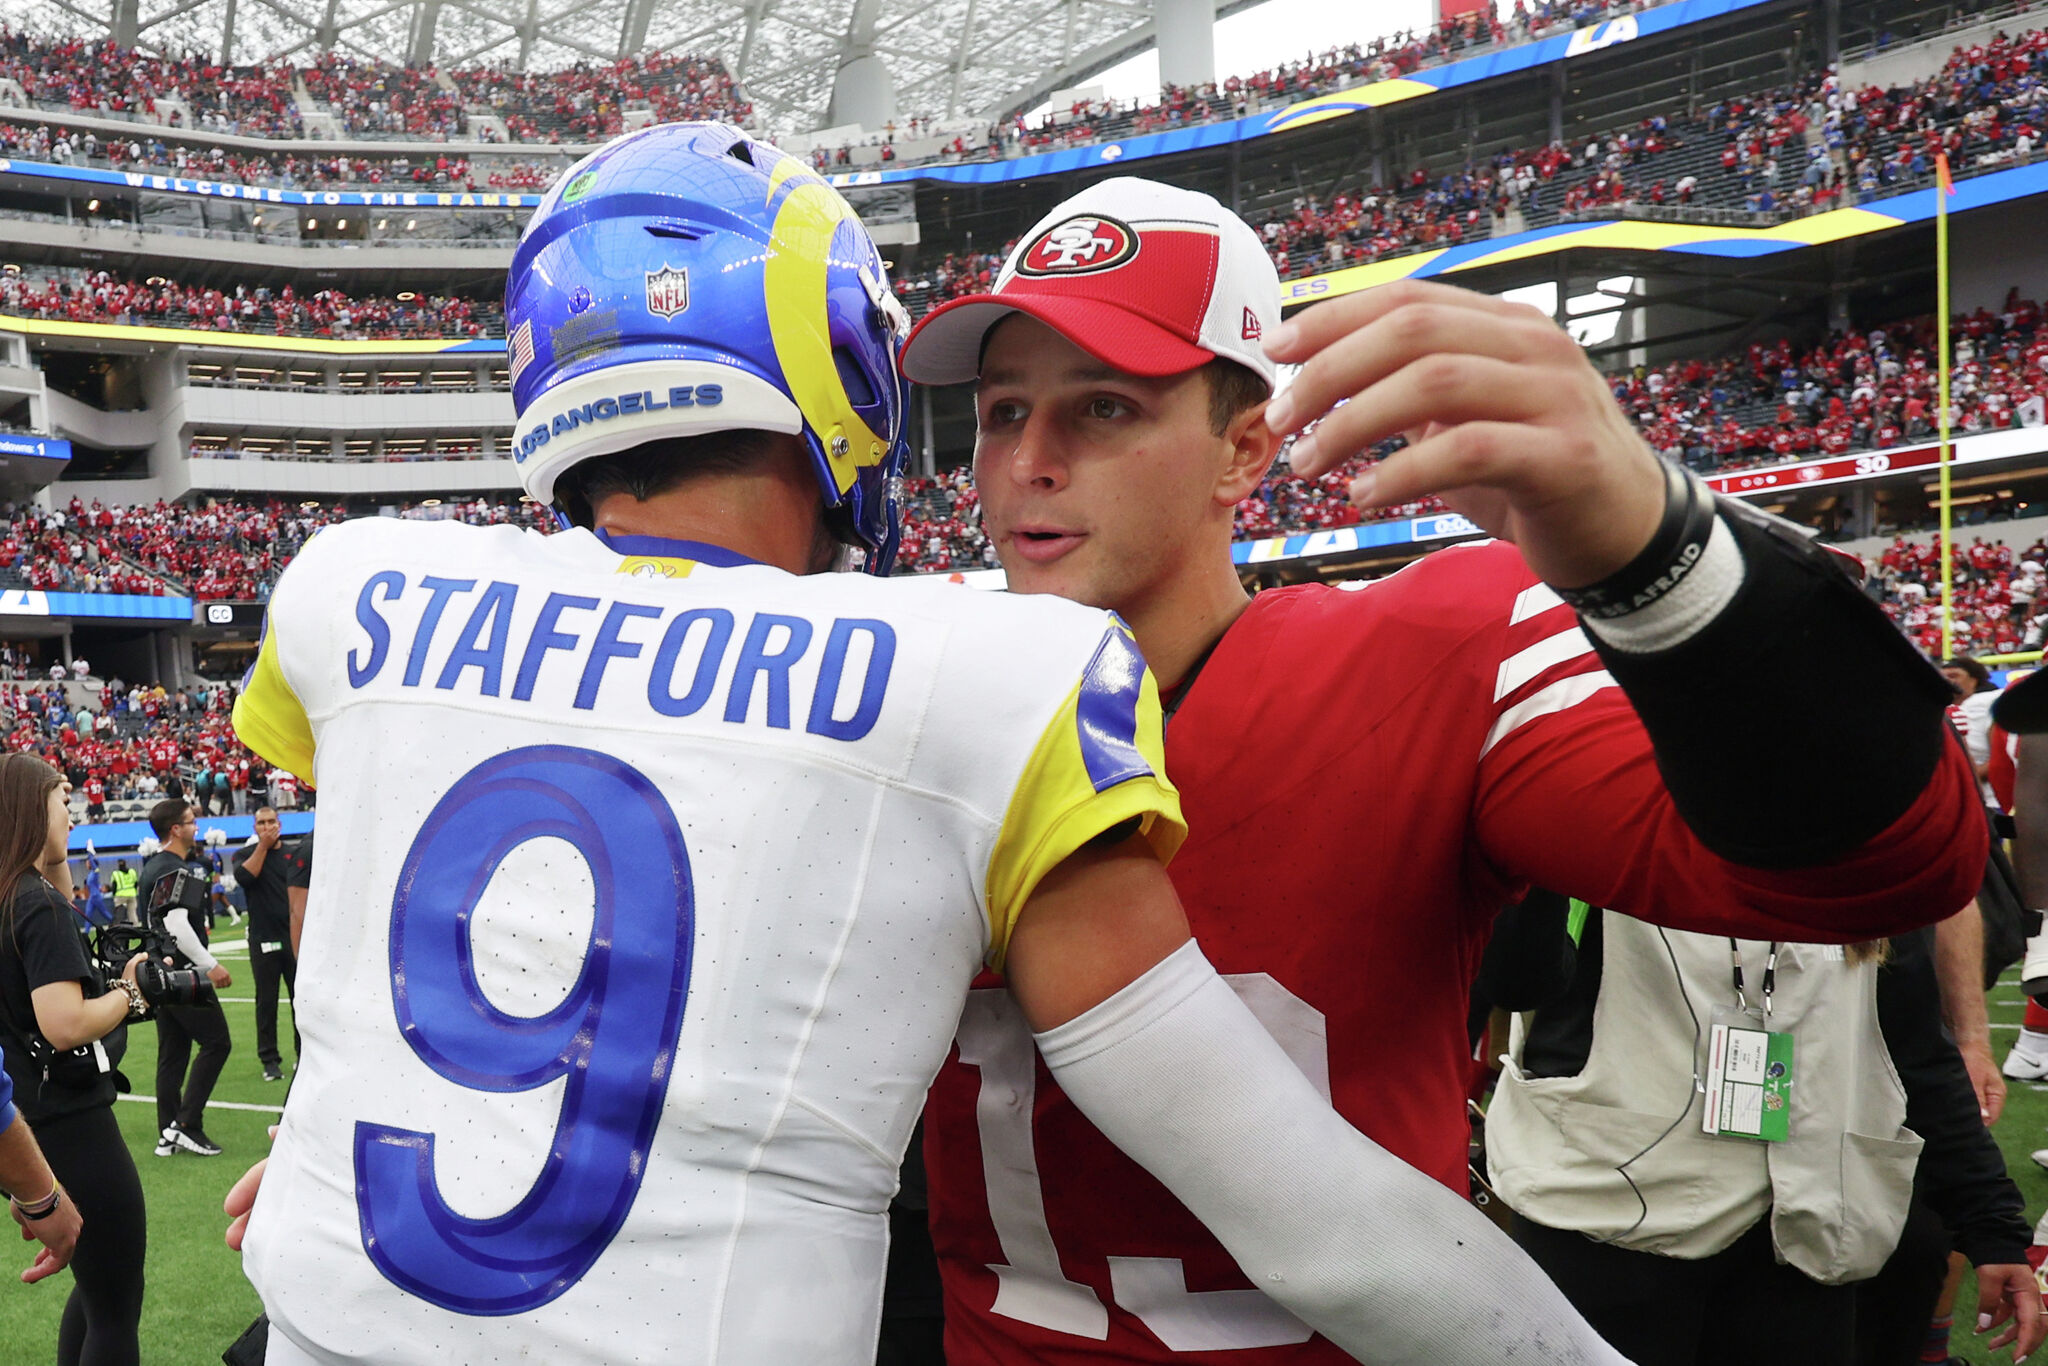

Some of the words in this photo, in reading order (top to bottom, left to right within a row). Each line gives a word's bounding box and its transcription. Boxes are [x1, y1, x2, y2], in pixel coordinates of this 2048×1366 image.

[1564, 15, 1638, 57] LA
[125, 172, 282, 202] WELCOME
[302, 192, 340, 206] TO
[361, 192, 417, 206] THE
[437, 194, 521, 207] RAMS
[1042, 220, 1114, 268] SF
[652, 287, 684, 312] NFL
[1281, 279, 1328, 300] ES
[513, 423, 550, 464] LOS
[551, 384, 724, 437] ANGELES
[37, 442, 46, 456] 1
[1855, 455, 1890, 475] 30
[1248, 527, 1359, 563] LA
[1633, 543, 1701, 608] AFRAID
[211, 608, 230, 620] CC
[347, 570, 897, 742] STAFFORD
[354, 744, 695, 1317] 9
